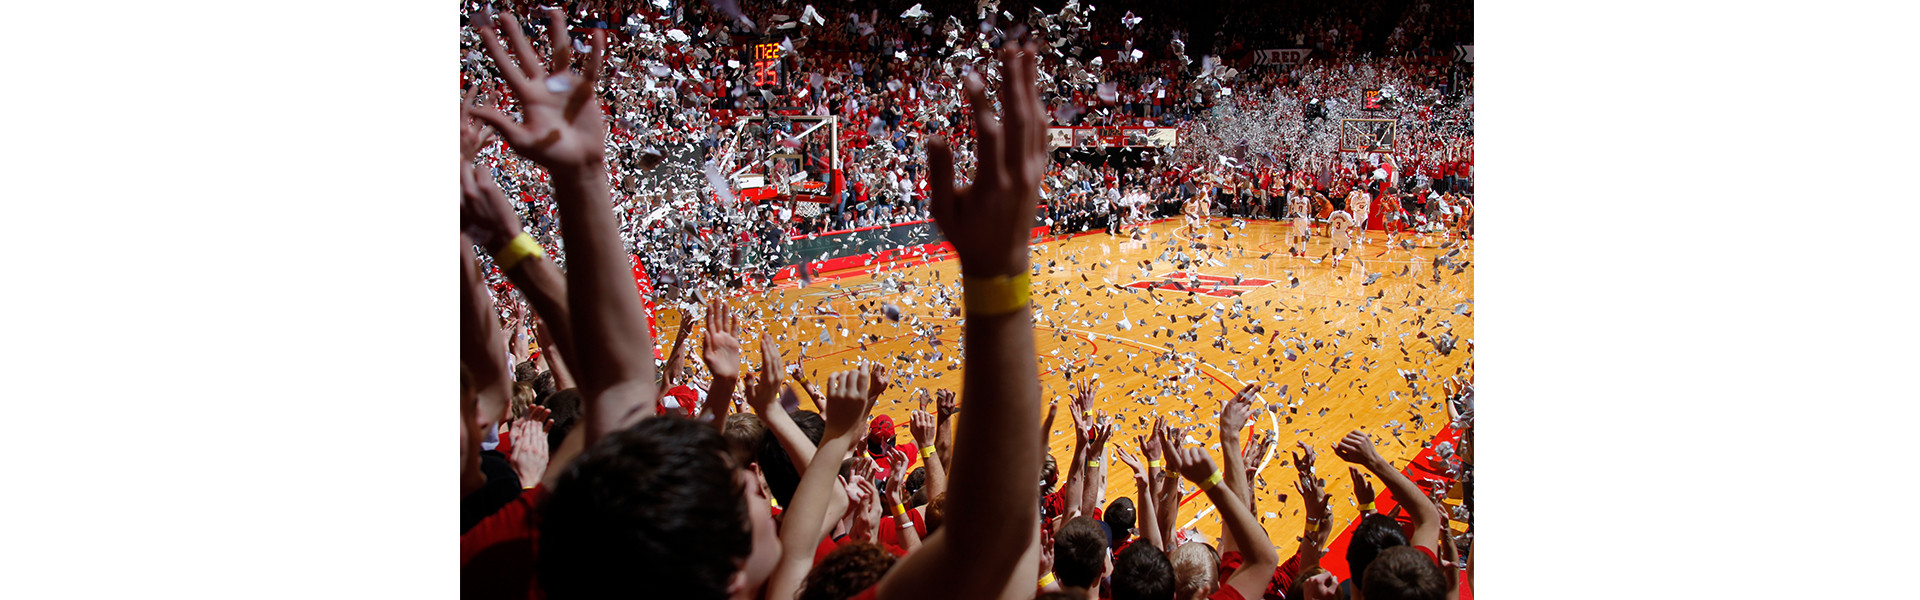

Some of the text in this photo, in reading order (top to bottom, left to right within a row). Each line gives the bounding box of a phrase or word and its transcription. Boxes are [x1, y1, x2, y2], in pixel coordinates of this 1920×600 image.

[755, 43, 779, 59] 17:22
[1271, 51, 1300, 63] RED
[754, 61, 777, 86] 35
[1336, 221, 1341, 230] 3
